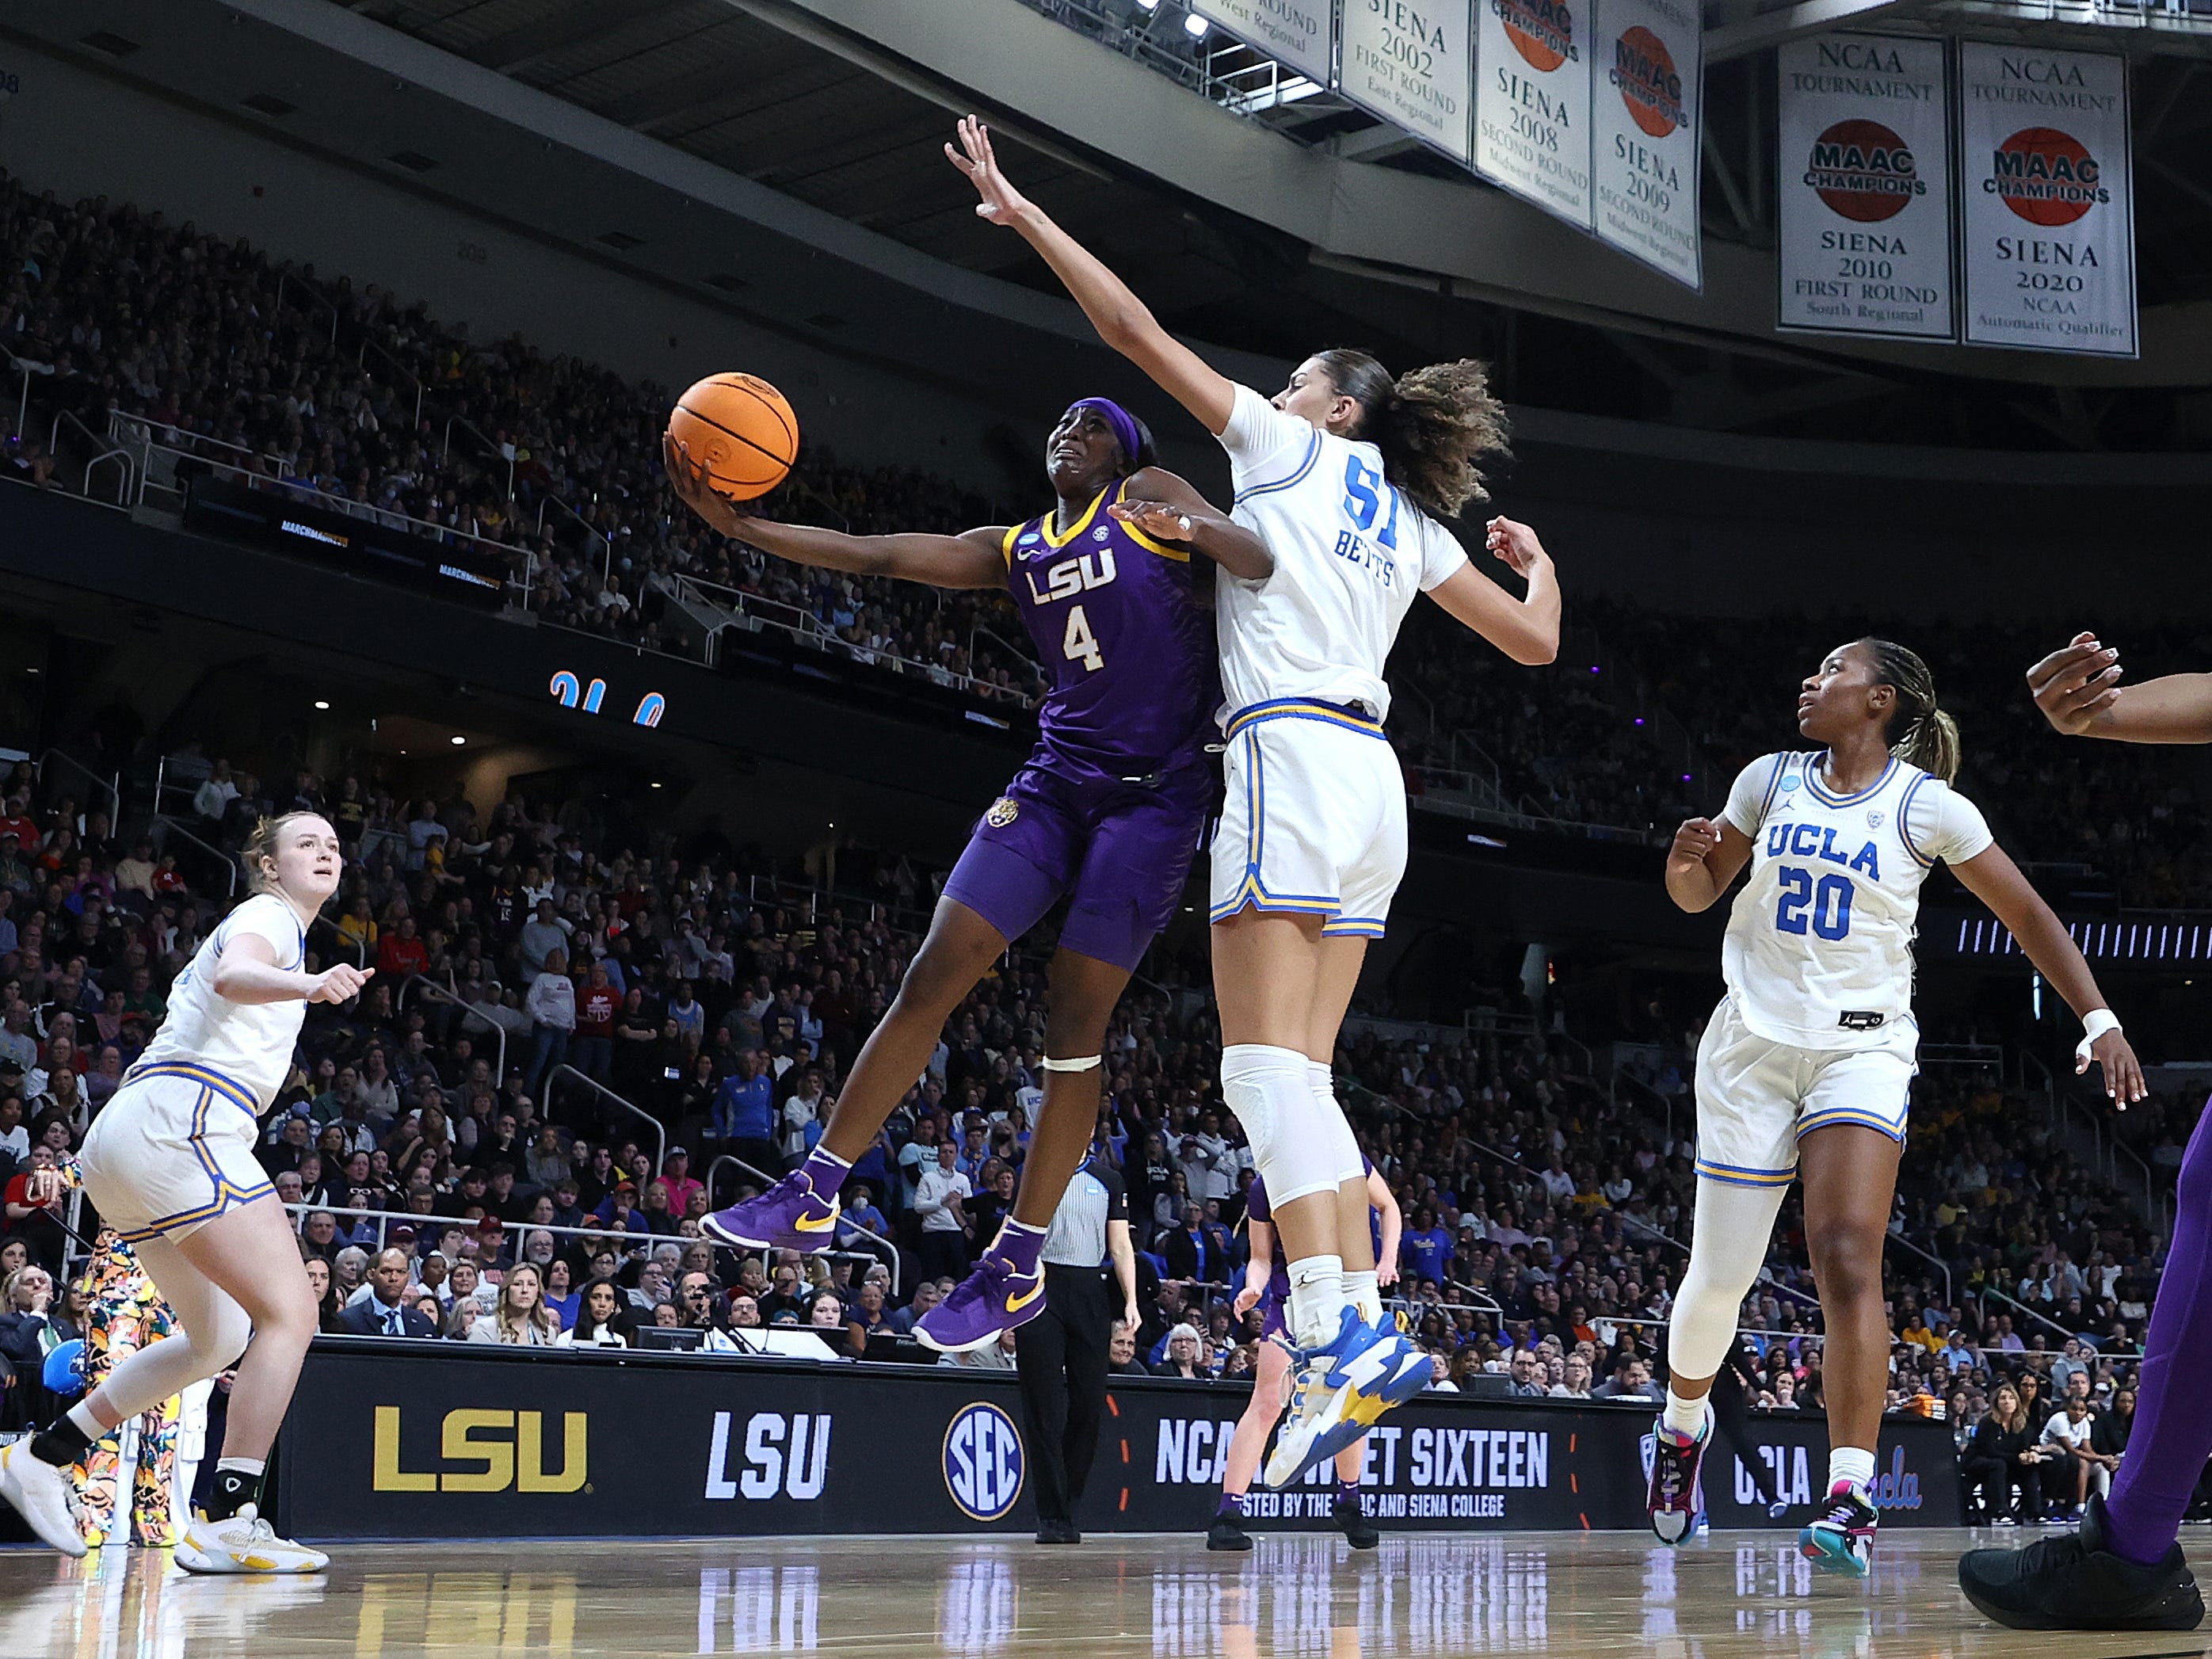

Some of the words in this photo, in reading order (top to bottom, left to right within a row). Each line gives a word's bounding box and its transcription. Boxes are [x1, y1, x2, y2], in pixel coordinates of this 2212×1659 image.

[1381, 27, 1433, 78] 2002
[1615, 39, 1682, 101] MAAC
[1817, 42, 1905, 74] NCAA
[2001, 57, 2086, 87] NCAA
[1356, 44, 1394, 81] FIRST
[1400, 71, 1456, 114] ROUND
[1498, 67, 1569, 128] SIENA
[1791, 72, 1933, 101] TOURNAMENT
[1970, 82, 2116, 113] TOURNAMENT
[1510, 106, 1558, 152] 2008
[1482, 120, 1534, 162] SECOND
[1538, 153, 1588, 190] ROUND
[1615, 133, 1680, 191] SIENA
[1814, 143, 1915, 174] MAAC
[1993, 150, 2100, 184] MAAC
[1627, 170, 1671, 213] 2009
[1803, 172, 1928, 196] CHAMPIONS
[1982, 177, 2111, 204] CHAMPIONS
[1821, 230, 1908, 256] SIENA
[1995, 236, 2099, 269] SIENA
[1838, 257, 1893, 280] 2010
[2016, 271, 2084, 293] 2020
[1795, 279, 1852, 298] FIRST
[1863, 284, 1939, 304] ROUND
[1806, 301, 1852, 317] South
[1857, 303, 1924, 322] Regional
[2023, 296, 2078, 316] NCAA
[1977, 315, 2050, 332] Automatic
[2058, 322, 2125, 337] Qualifier
[1344, 454, 1398, 551] 51
[1025, 547, 1117, 606] LSU
[1333, 529, 1394, 587] BETTS
[1063, 604, 1104, 671] 4
[1767, 823, 1880, 883] UCLA
[1776, 865, 1855, 942] 20
[372, 1405, 588, 1493] LSU
[704, 1410, 832, 1500] LSU
[950, 1410, 1018, 1512] SEC
[1155, 1418, 1263, 1484] NCA
[1410, 1427, 1549, 1488] SIXTEEN
[1239, 1492, 1280, 1517] STED
[1283, 1493, 1304, 1517] BY
[1306, 1493, 1333, 1518] THE
[1378, 1493, 1406, 1518] AND
[1409, 1494, 1448, 1518] SIENA
[1451, 1493, 1505, 1519] COLLEGE
